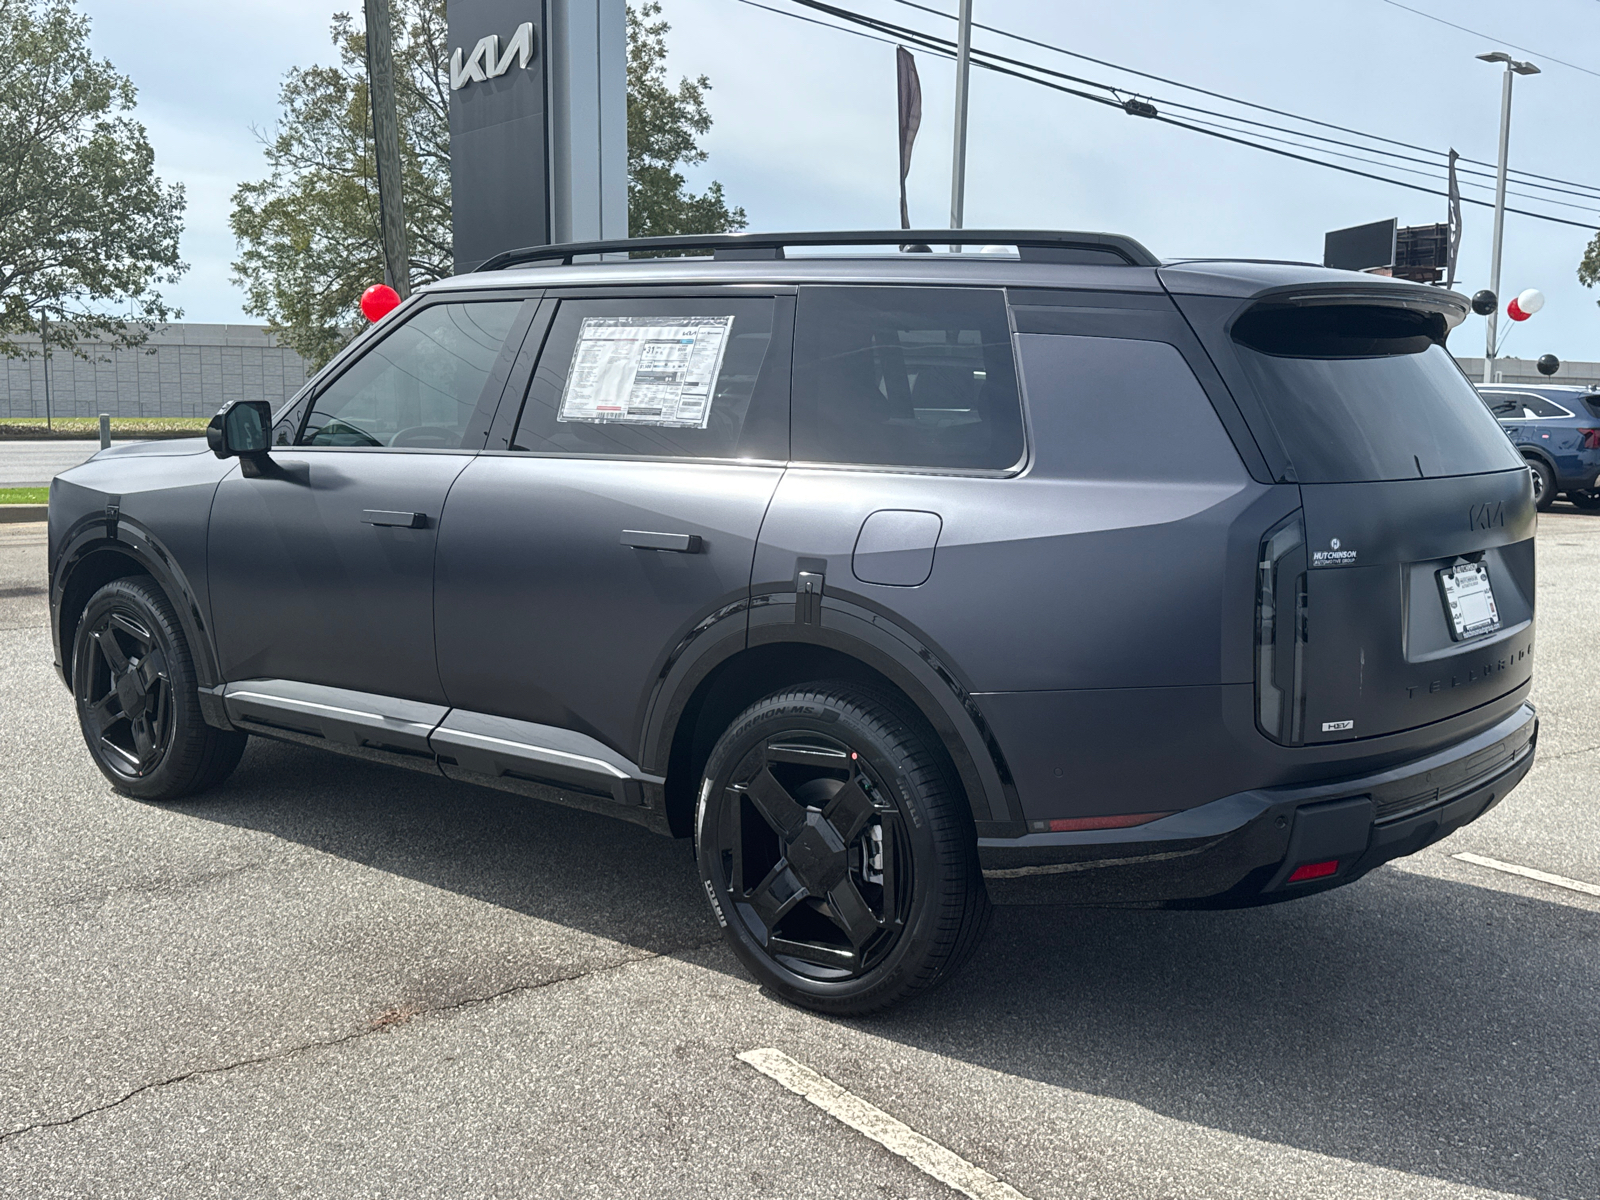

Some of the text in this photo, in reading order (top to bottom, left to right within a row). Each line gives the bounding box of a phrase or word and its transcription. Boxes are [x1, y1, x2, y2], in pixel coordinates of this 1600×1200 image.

[450, 22, 534, 91] KIA
[1469, 500, 1505, 532] KIA
[1313, 550, 1358, 560] HUTCHINSON
[720, 705, 815, 754] SCORPION MS
[1327, 721, 1351, 730] HEV
[896, 775, 922, 829] PIRELLI
